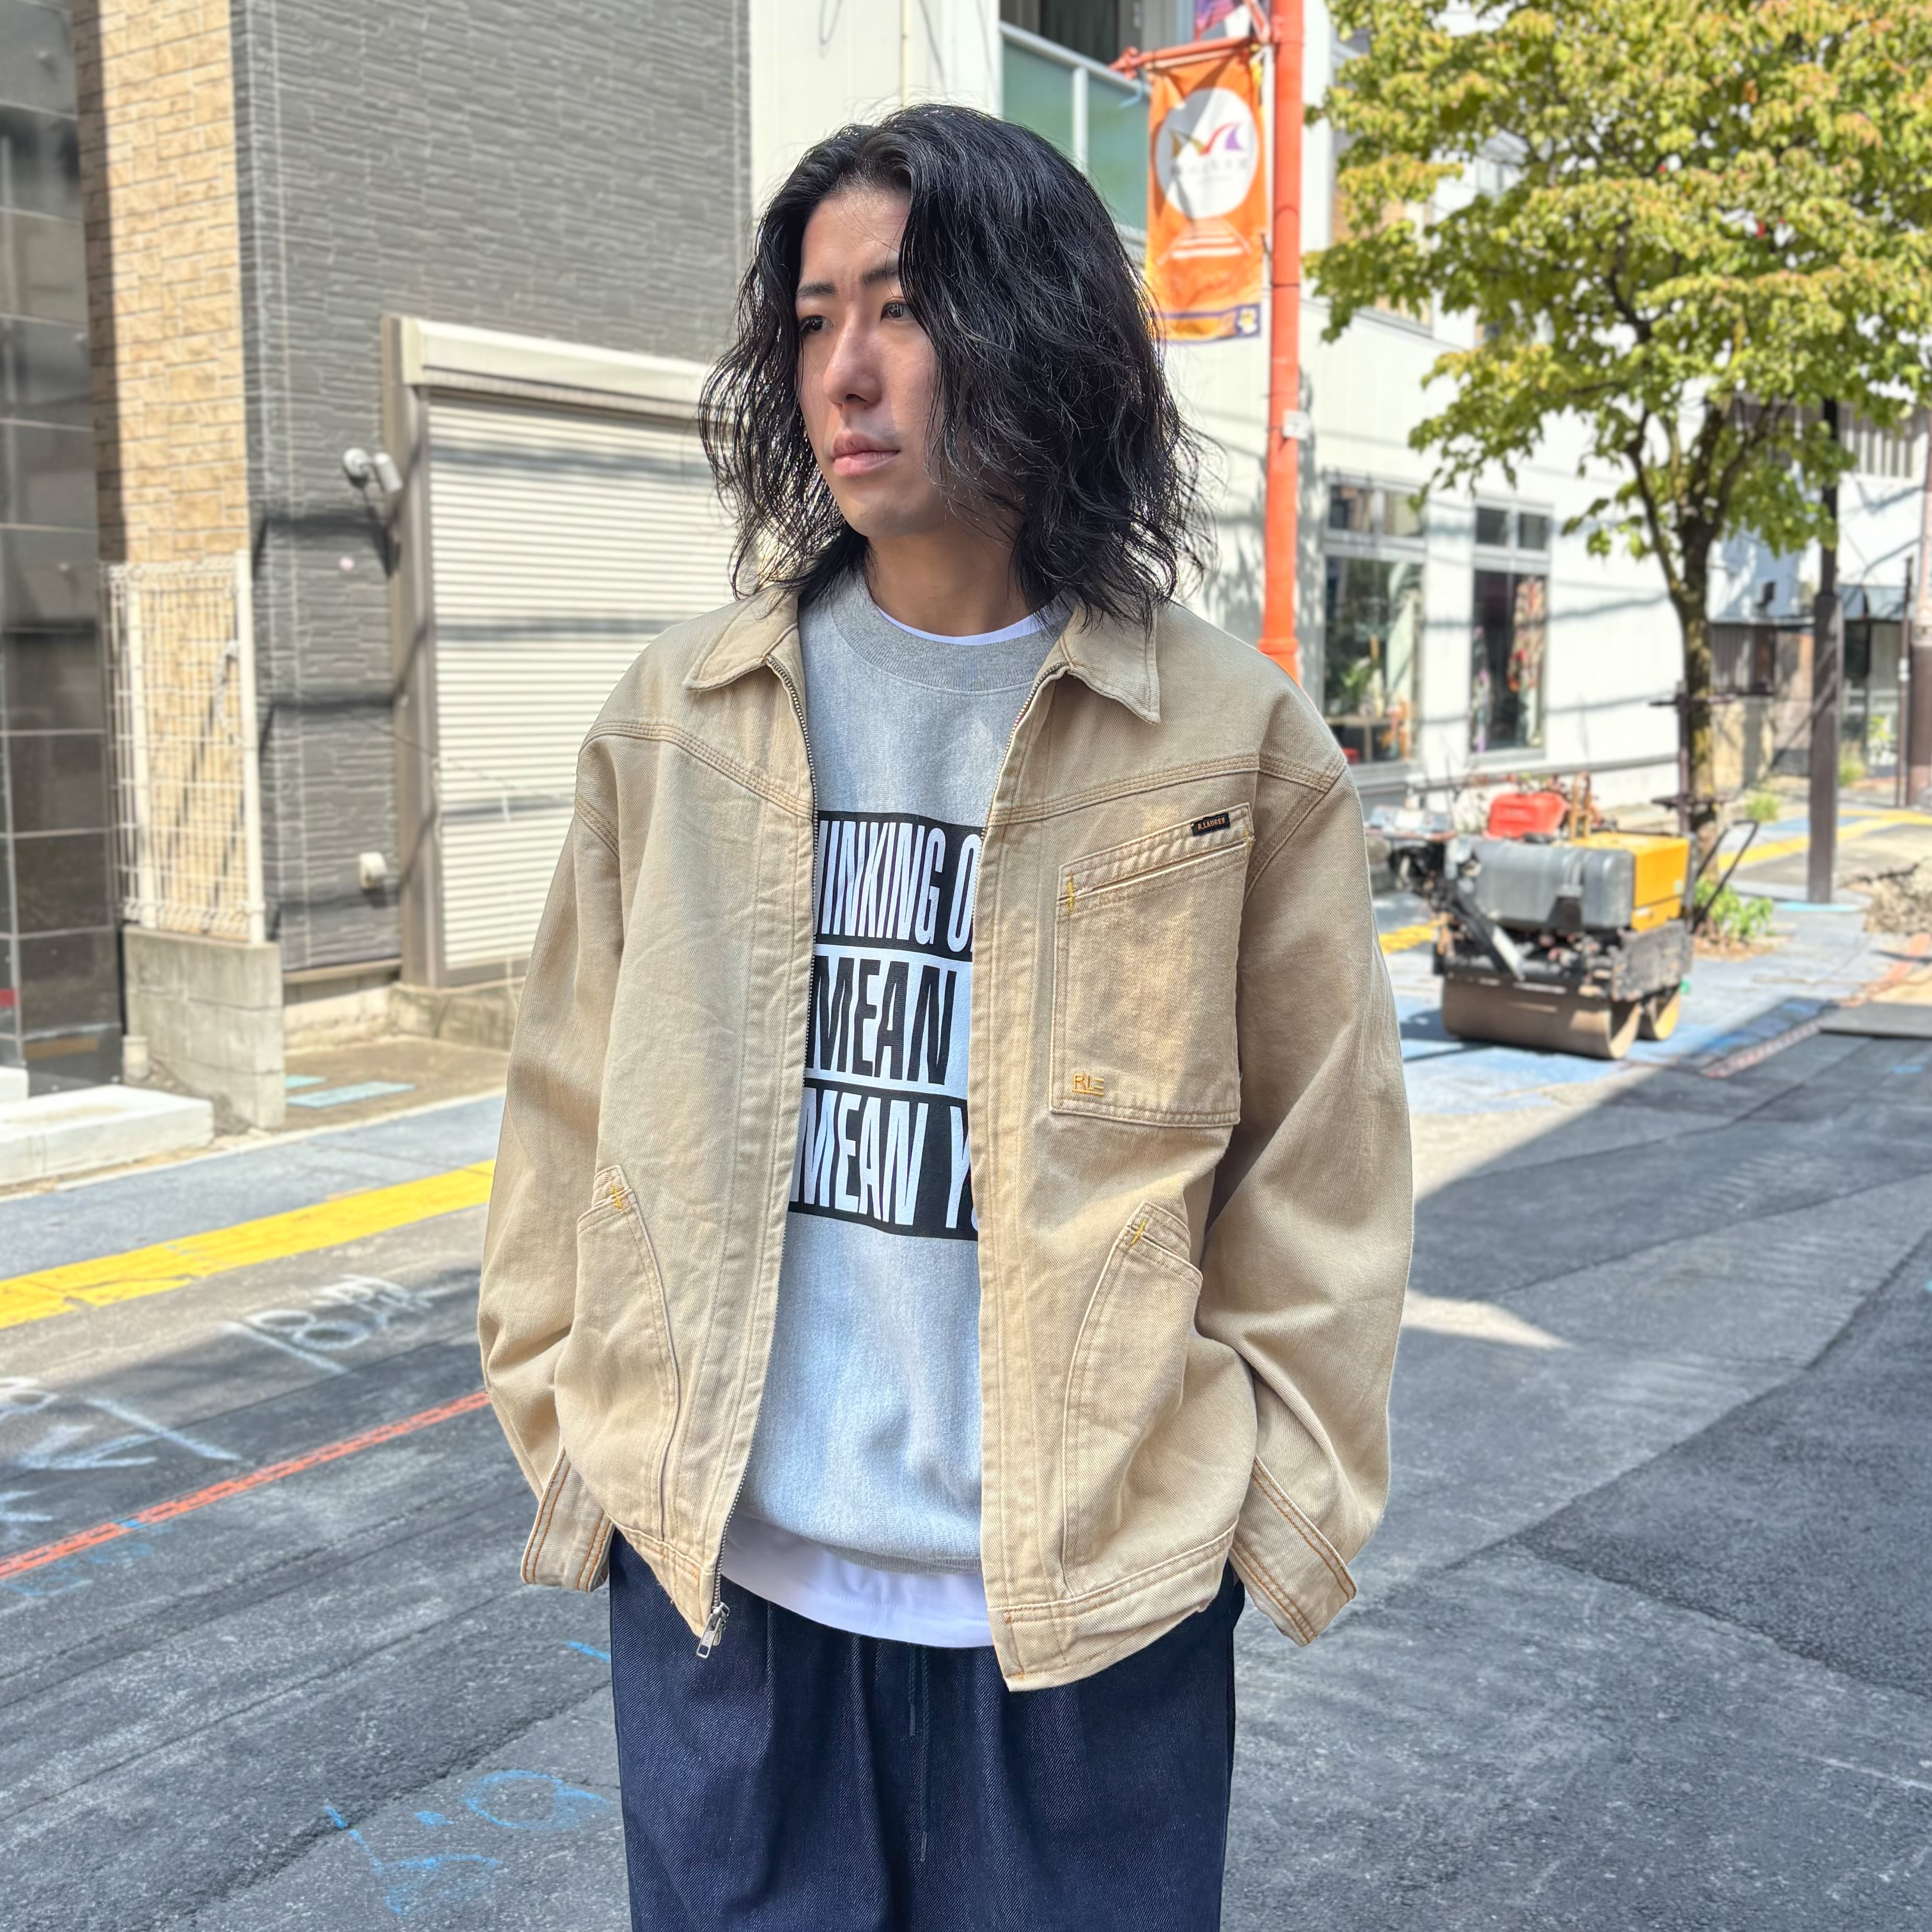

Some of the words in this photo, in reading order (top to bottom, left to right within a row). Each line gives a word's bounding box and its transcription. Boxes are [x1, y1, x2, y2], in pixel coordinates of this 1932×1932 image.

[947, 834, 982, 953] O
[805, 955, 957, 1085] MEAN
[790, 1087, 929, 1226] MEAN
[945, 1105, 978, 1232] Y
